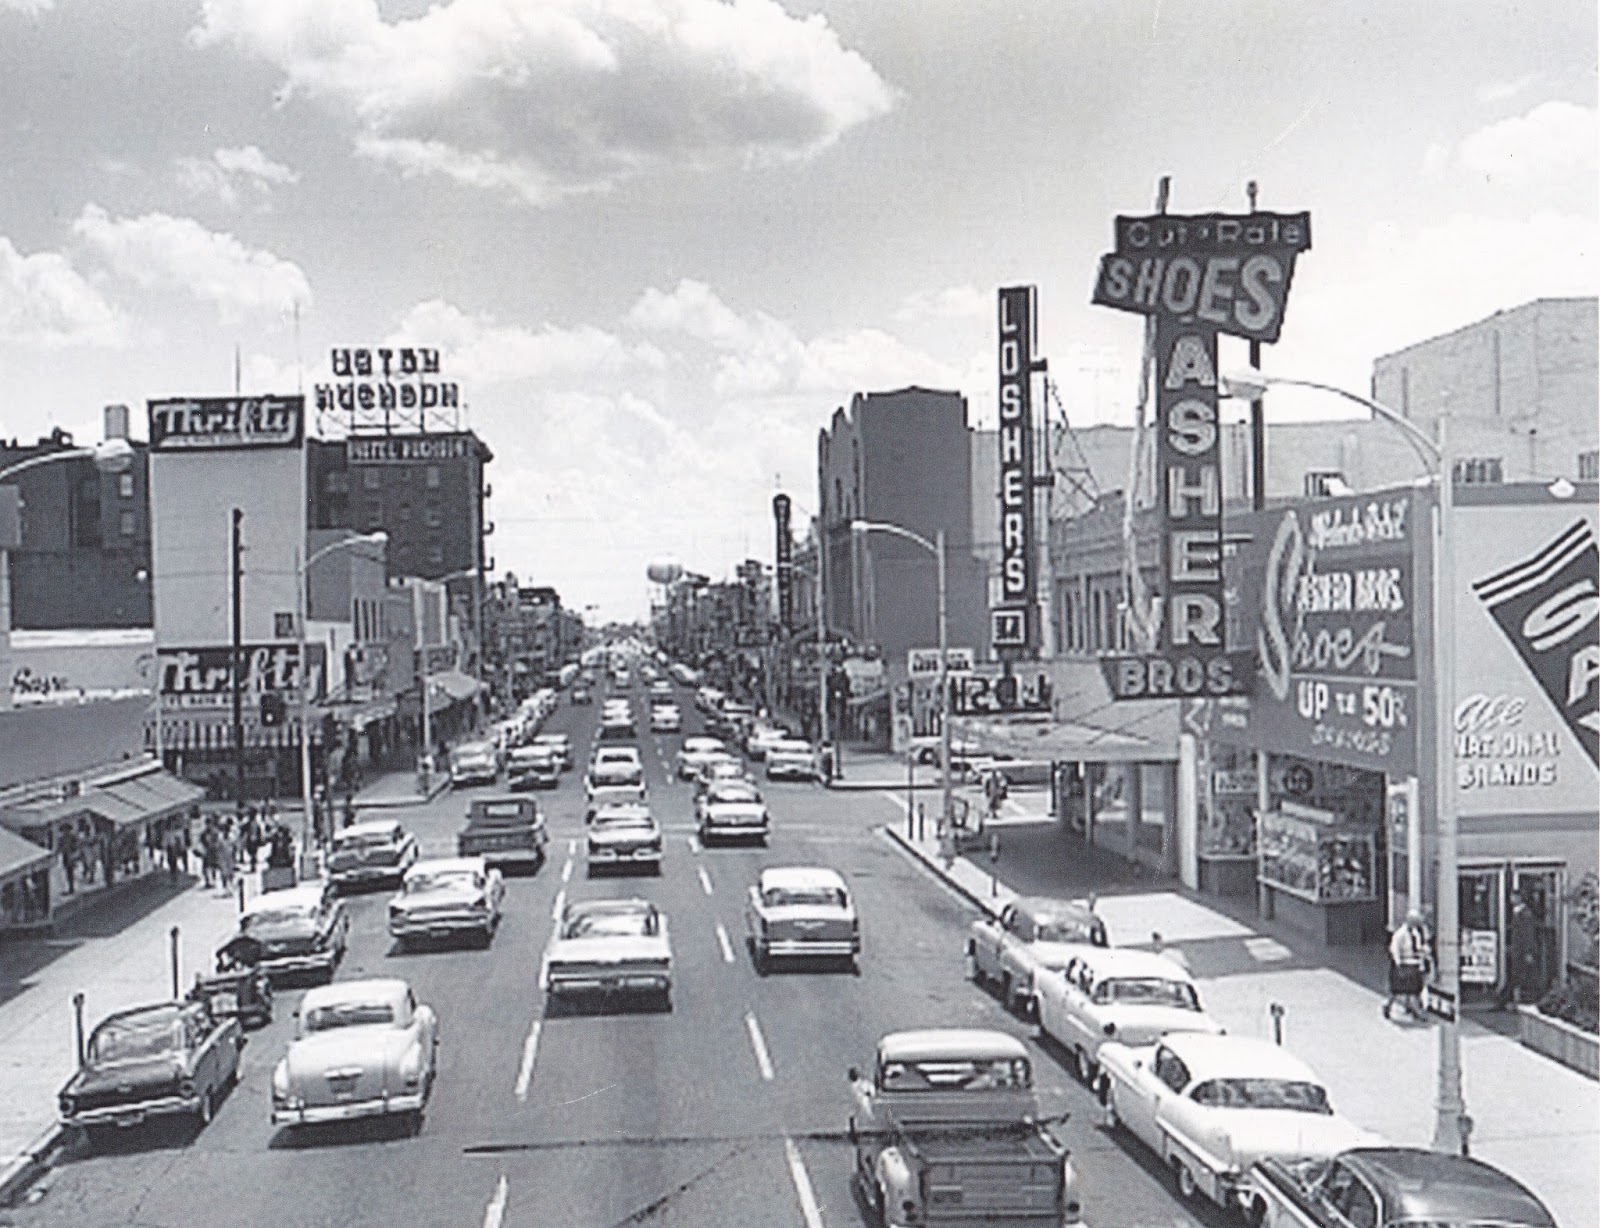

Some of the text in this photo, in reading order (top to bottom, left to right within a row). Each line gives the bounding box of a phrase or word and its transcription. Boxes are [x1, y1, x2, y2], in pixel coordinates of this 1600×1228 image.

[1104, 254, 1284, 331] SHOES
[152, 401, 298, 443] Thrifty
[1164, 335, 1221, 646] ASHER
[1522, 578, 1600, 733] SA
[1299, 681, 1329, 720] UP
